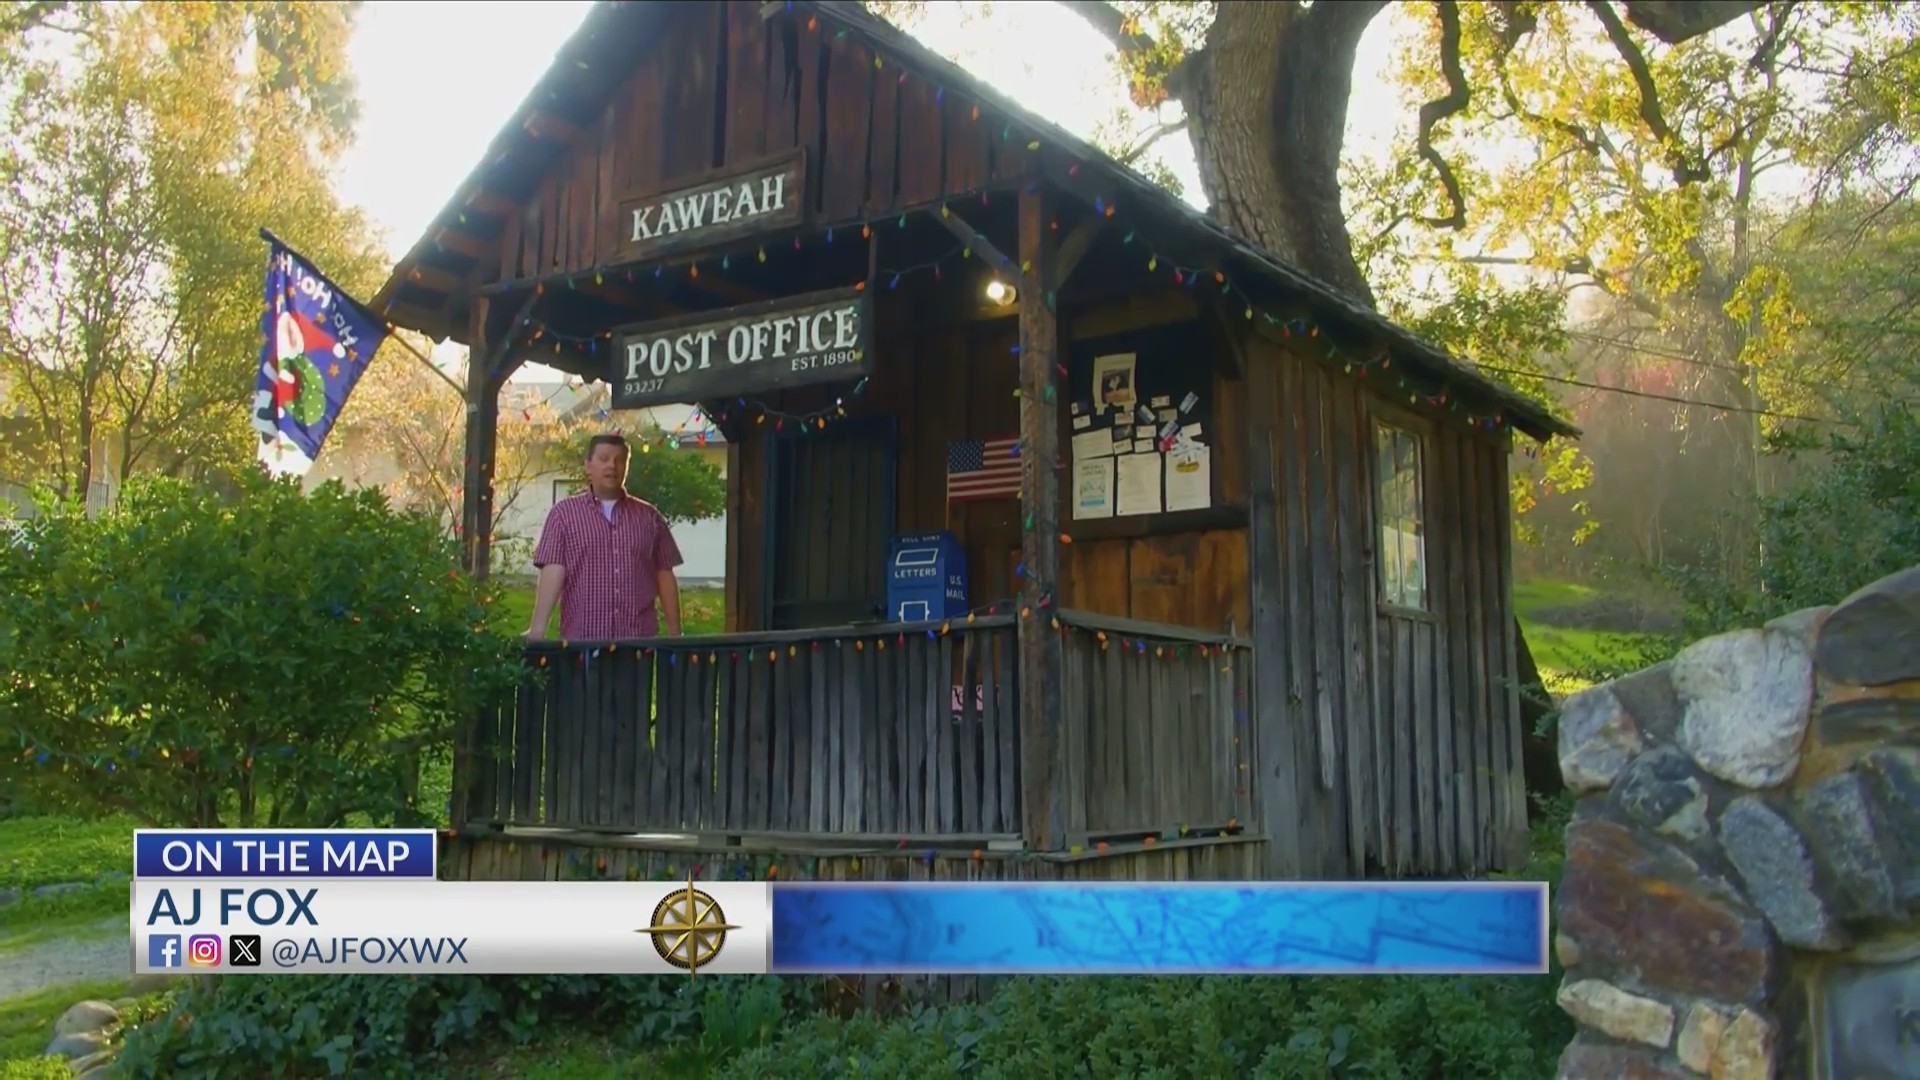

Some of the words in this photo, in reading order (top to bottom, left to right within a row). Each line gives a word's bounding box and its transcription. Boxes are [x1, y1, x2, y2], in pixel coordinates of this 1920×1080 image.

[631, 173, 786, 242] KAWEAH
[625, 329, 717, 380] POST
[727, 306, 859, 364] OFFICE
[791, 355, 819, 372] EST.
[823, 349, 856, 367] 1890
[624, 378, 665, 395] 93237
[894, 567, 937, 579] LETTERS
[946, 588, 966, 601] MAIL
